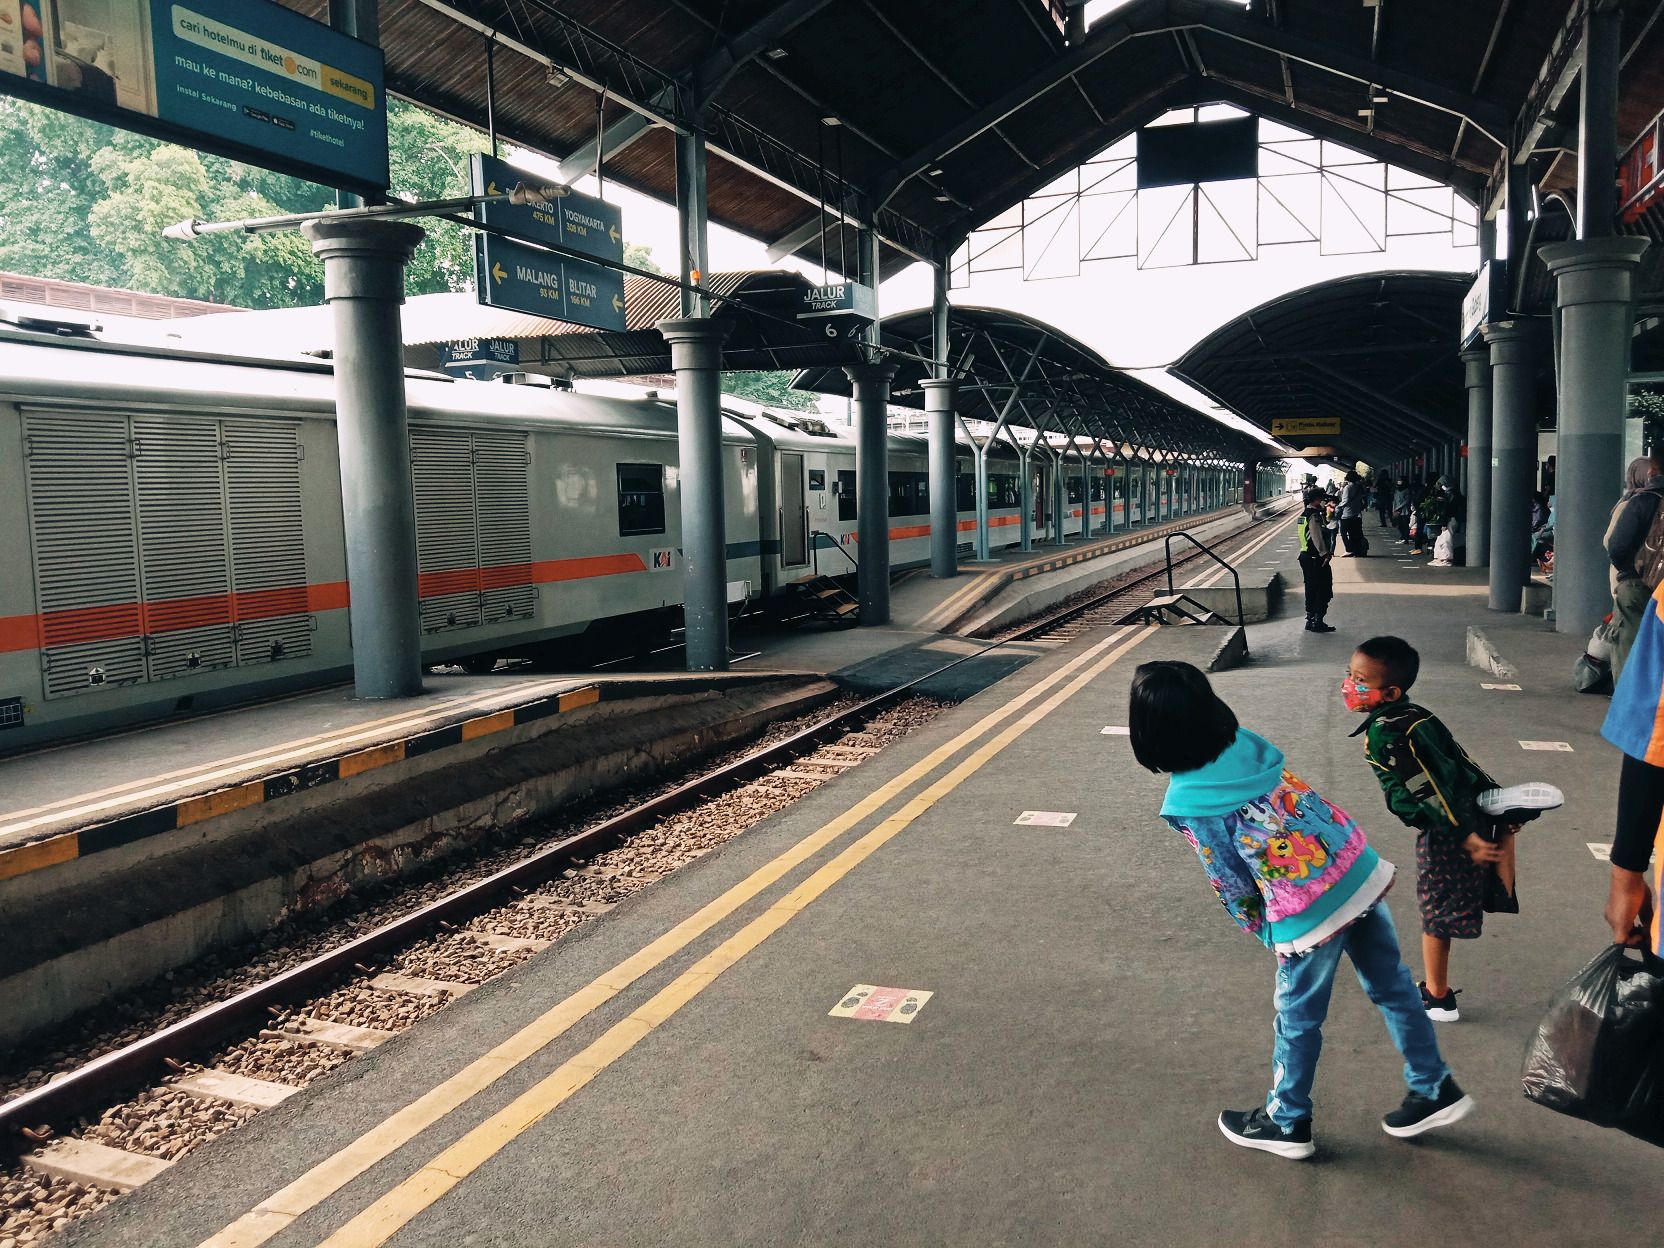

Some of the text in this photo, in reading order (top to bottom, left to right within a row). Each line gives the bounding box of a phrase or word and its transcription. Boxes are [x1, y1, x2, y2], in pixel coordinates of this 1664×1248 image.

[180, 19, 200, 34] cari
[203, 25, 245, 51] hotelmu
[247, 44, 257, 56] di
[175, 55, 365, 130] mau ke mana? kebebasan ada tiketnya!
[330, 77, 368, 101] sekarang
[176, 84, 237, 112] Instal Sekarang
[533, 210, 555, 226] 475 KM
[564, 208, 605, 232] YOGYAKARTA
[577, 225, 587, 236] KM
[516, 265, 558, 289] MALANG
[548, 289, 559, 300] KM
[569, 278, 597, 299] BLITAR
[803, 286, 845, 301] JALUR
[581, 297, 590, 307] KM
[812, 300, 837, 310] TRACK
[825, 323, 838, 337] 6
[490, 339, 514, 354] JALUR
[452, 351, 472, 360] TRACK
